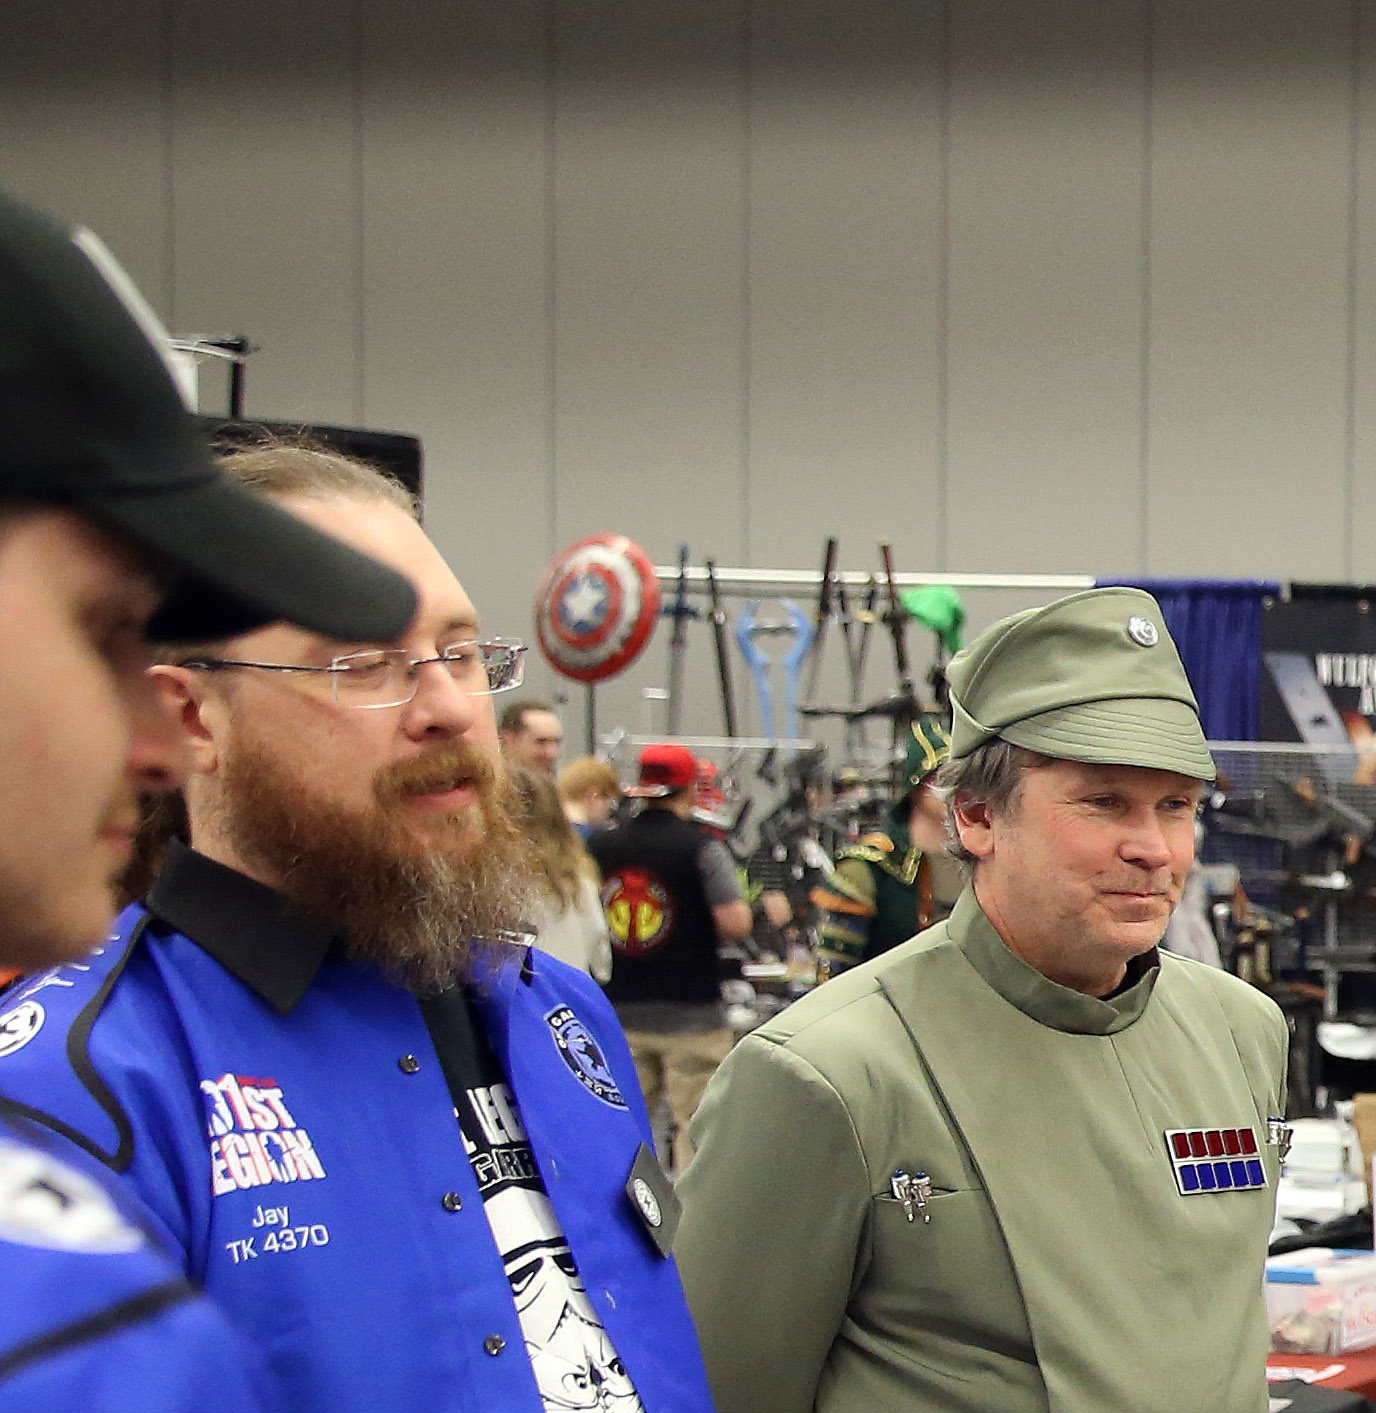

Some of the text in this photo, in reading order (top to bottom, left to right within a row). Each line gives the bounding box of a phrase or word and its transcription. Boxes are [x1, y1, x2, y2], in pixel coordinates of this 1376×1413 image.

[253, 1205, 290, 1228] Jay
[226, 1224, 330, 1263] TK 4370
